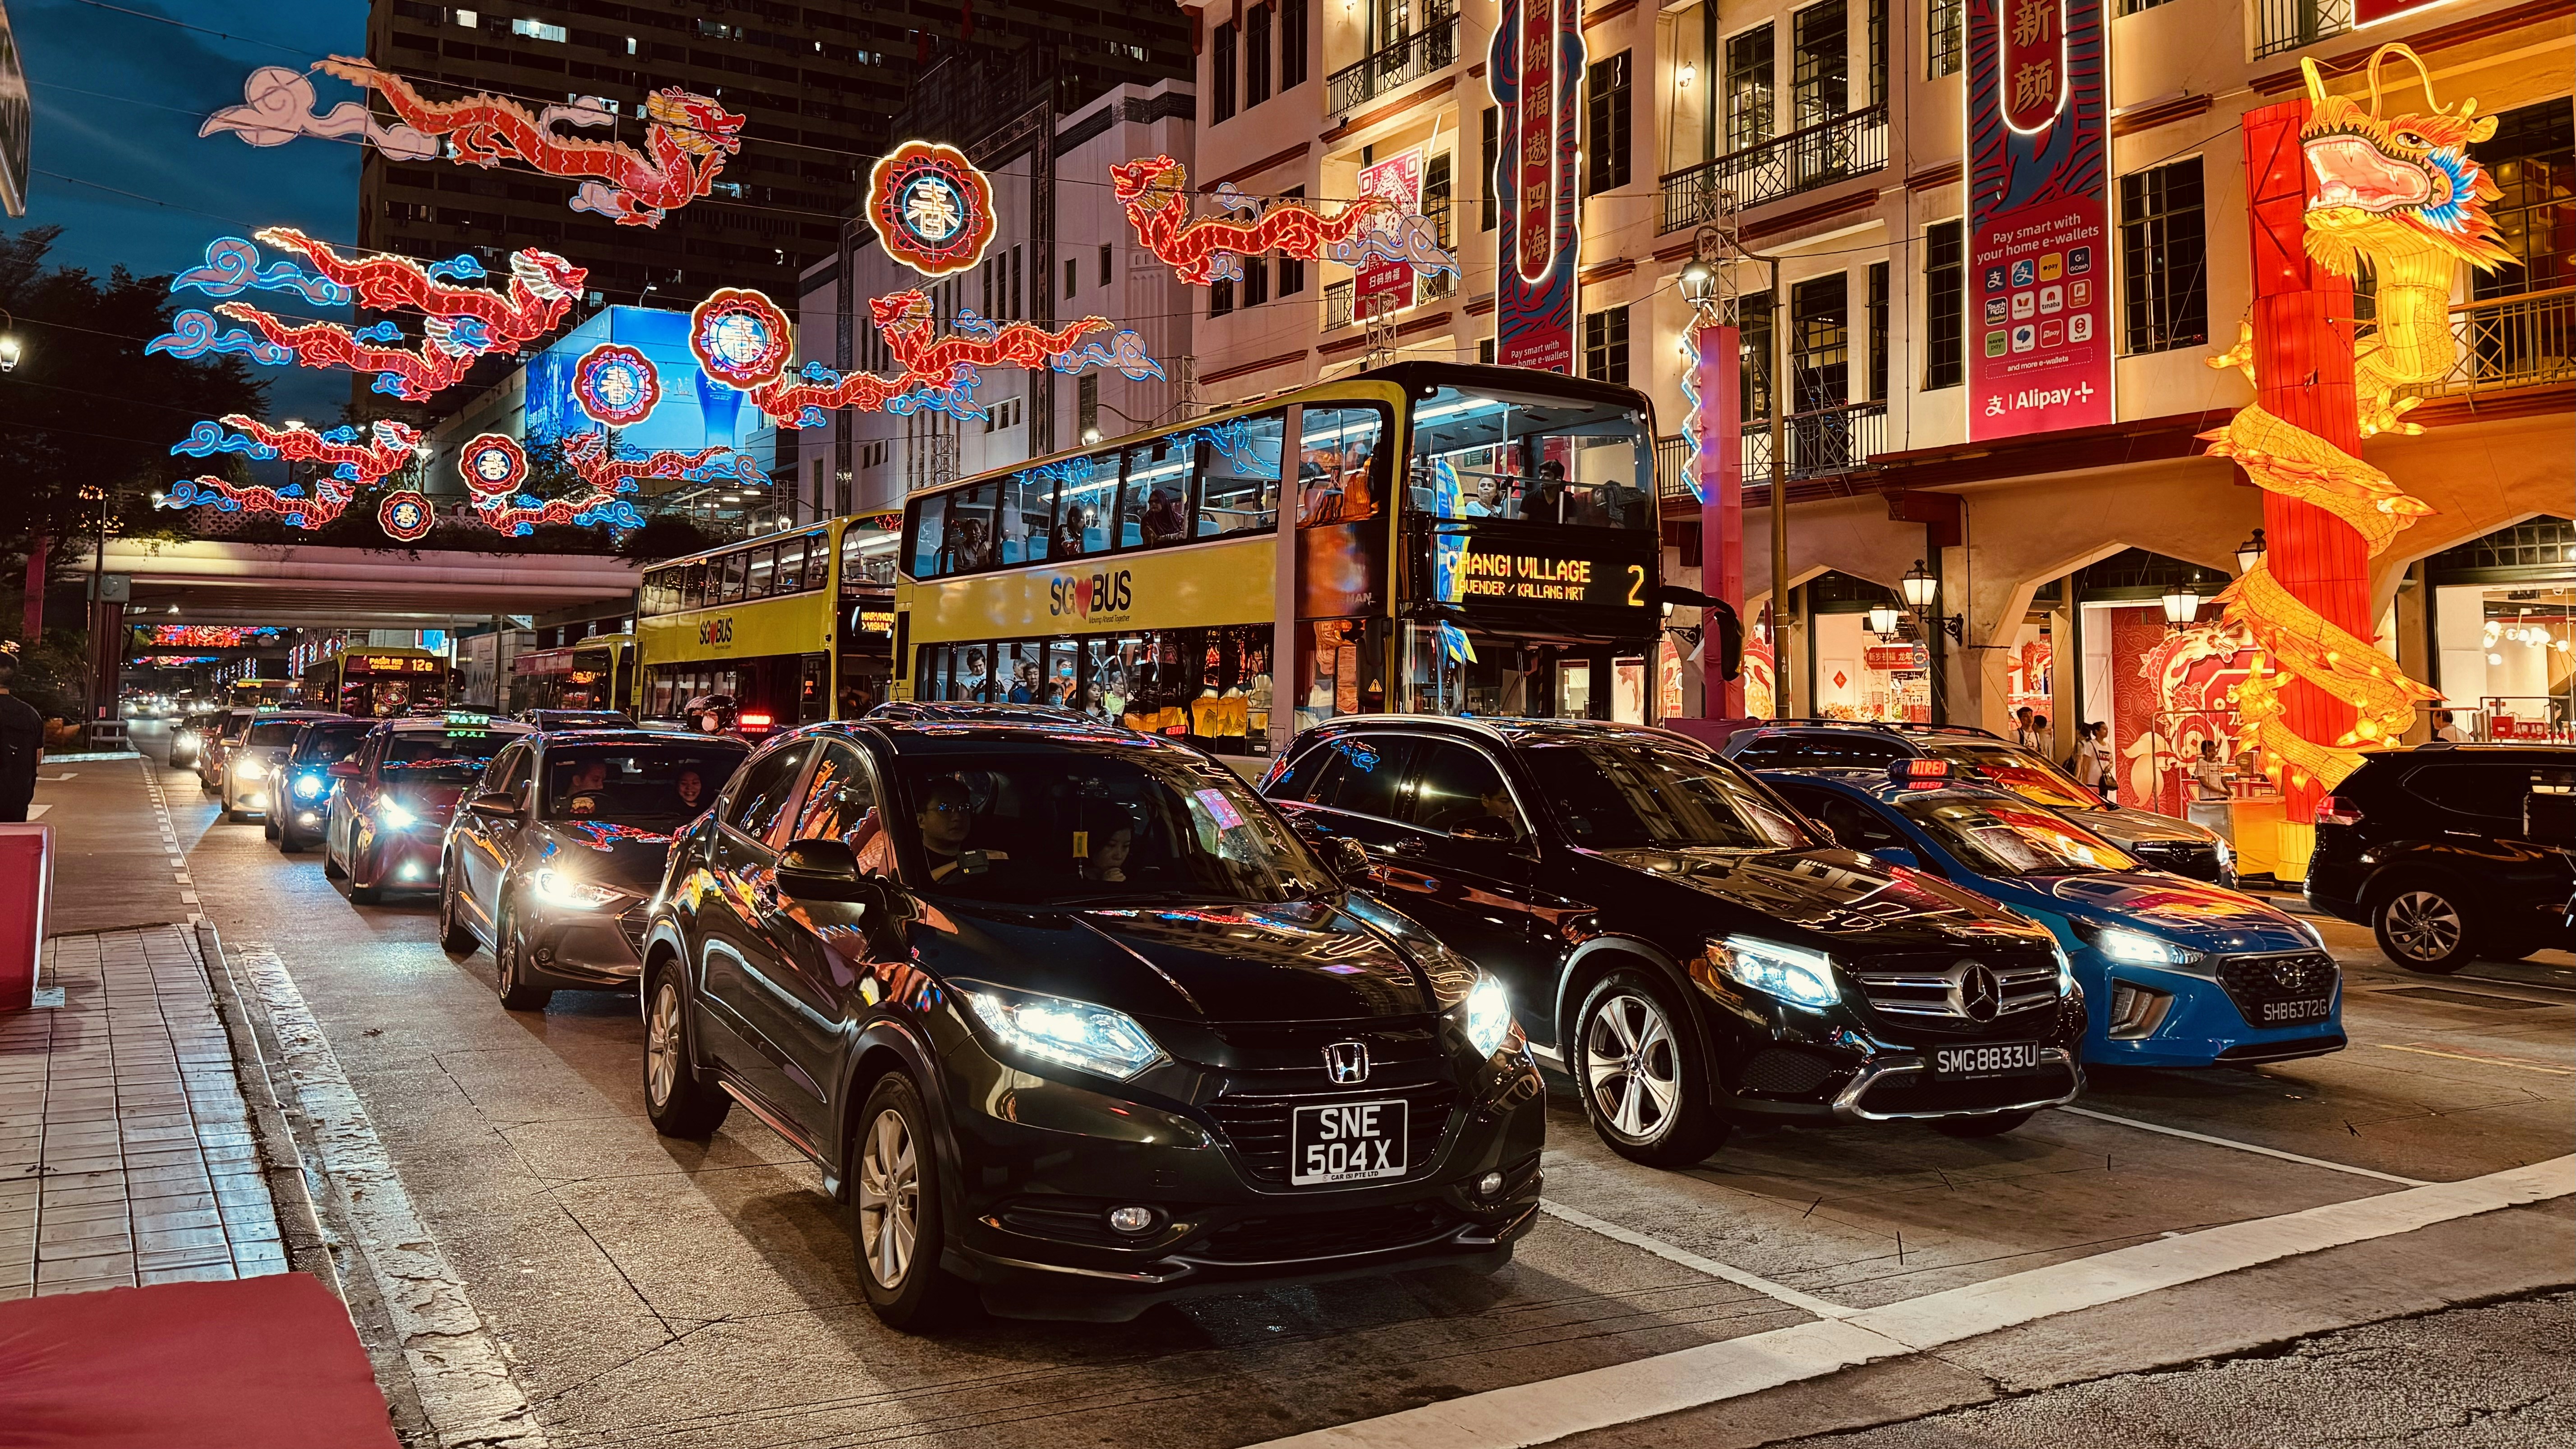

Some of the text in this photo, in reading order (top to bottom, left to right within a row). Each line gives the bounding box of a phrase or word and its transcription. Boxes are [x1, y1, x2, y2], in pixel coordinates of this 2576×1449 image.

[907, 177, 960, 240] 春
[1993, 213, 2081, 244] Pay smart with
[1977, 226, 2099, 265] your home e-wallets
[1369, 267, 1400, 289] 扫码纳福
[2048, 263, 2058, 271] pay
[2070, 263, 2088, 272] GCash
[1987, 301, 2006, 311] Touch
[2041, 301, 2060, 310] tinaba
[1511, 340, 1559, 359] Pay smart with
[1518, 358, 1537, 368] home
[1538, 350, 1569, 364] e-wallets
[2007, 355, 2069, 372] and more e-wallets
[599, 366, 636, 404] 春
[479, 450, 507, 480] 春
[1446, 551, 1645, 606] CHANGI VILLAGE 2
[1346, 592, 1372, 603] MAN
[1452, 579, 1506, 596] LAVENDER
[1518, 583, 1563, 600] KALLANG
[1565, 586, 1585, 601] MRT
[1089, 614, 1130, 625] Moving Ahead Together
[411, 659, 433, 671] 12e
[1911, 761, 1948, 775] HIRED
[2263, 998, 2327, 1021] SHB6372G
[1937, 1045, 2036, 1073] SMG8833U
[1320, 1105, 1381, 1140] SNE
[1307, 1139, 1392, 1176] 504X
